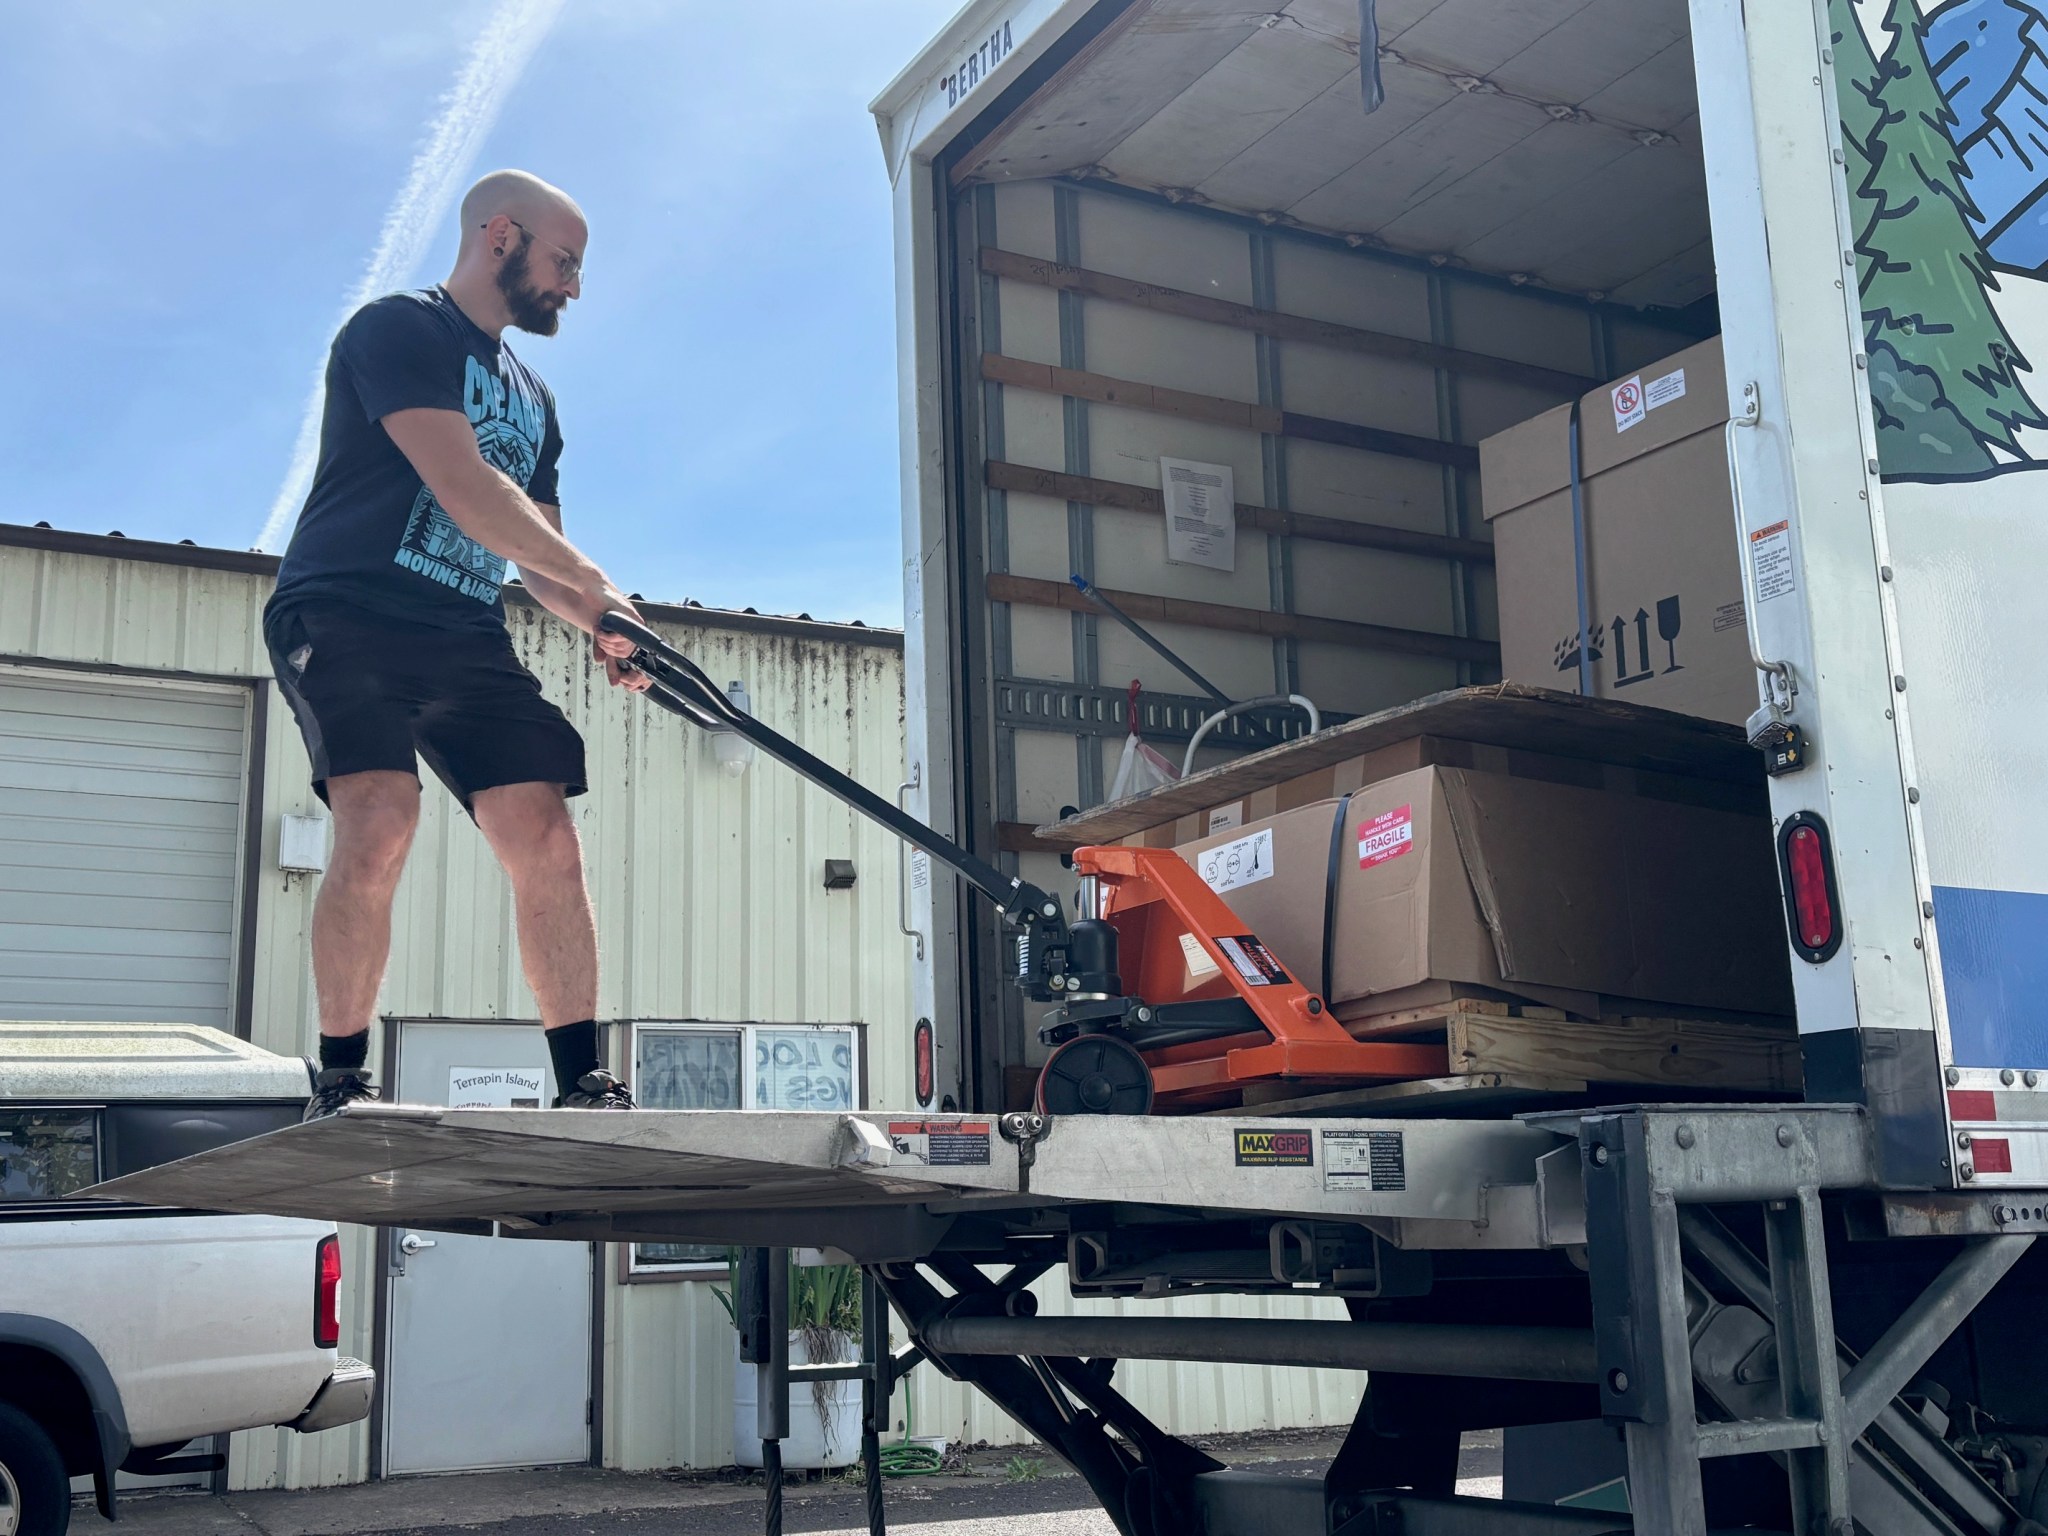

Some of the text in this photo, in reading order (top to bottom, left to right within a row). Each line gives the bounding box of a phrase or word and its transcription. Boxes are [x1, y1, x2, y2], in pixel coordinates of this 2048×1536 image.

[947, 19, 1013, 110] BERTHA
[1762, 522, 1784, 534] WARNING
[393, 547, 461, 589] MOVING
[459, 575, 471, 596] &
[1364, 815, 1404, 836] HANDLE WITH CARE
[1374, 812, 1393, 825] PLEASE
[1365, 826, 1405, 853] FRAGILE
[453, 1072, 540, 1091] Terrapin Island
[929, 1124, 963, 1133] WARNING
[1242, 1136, 1308, 1152] MAXGRIP
